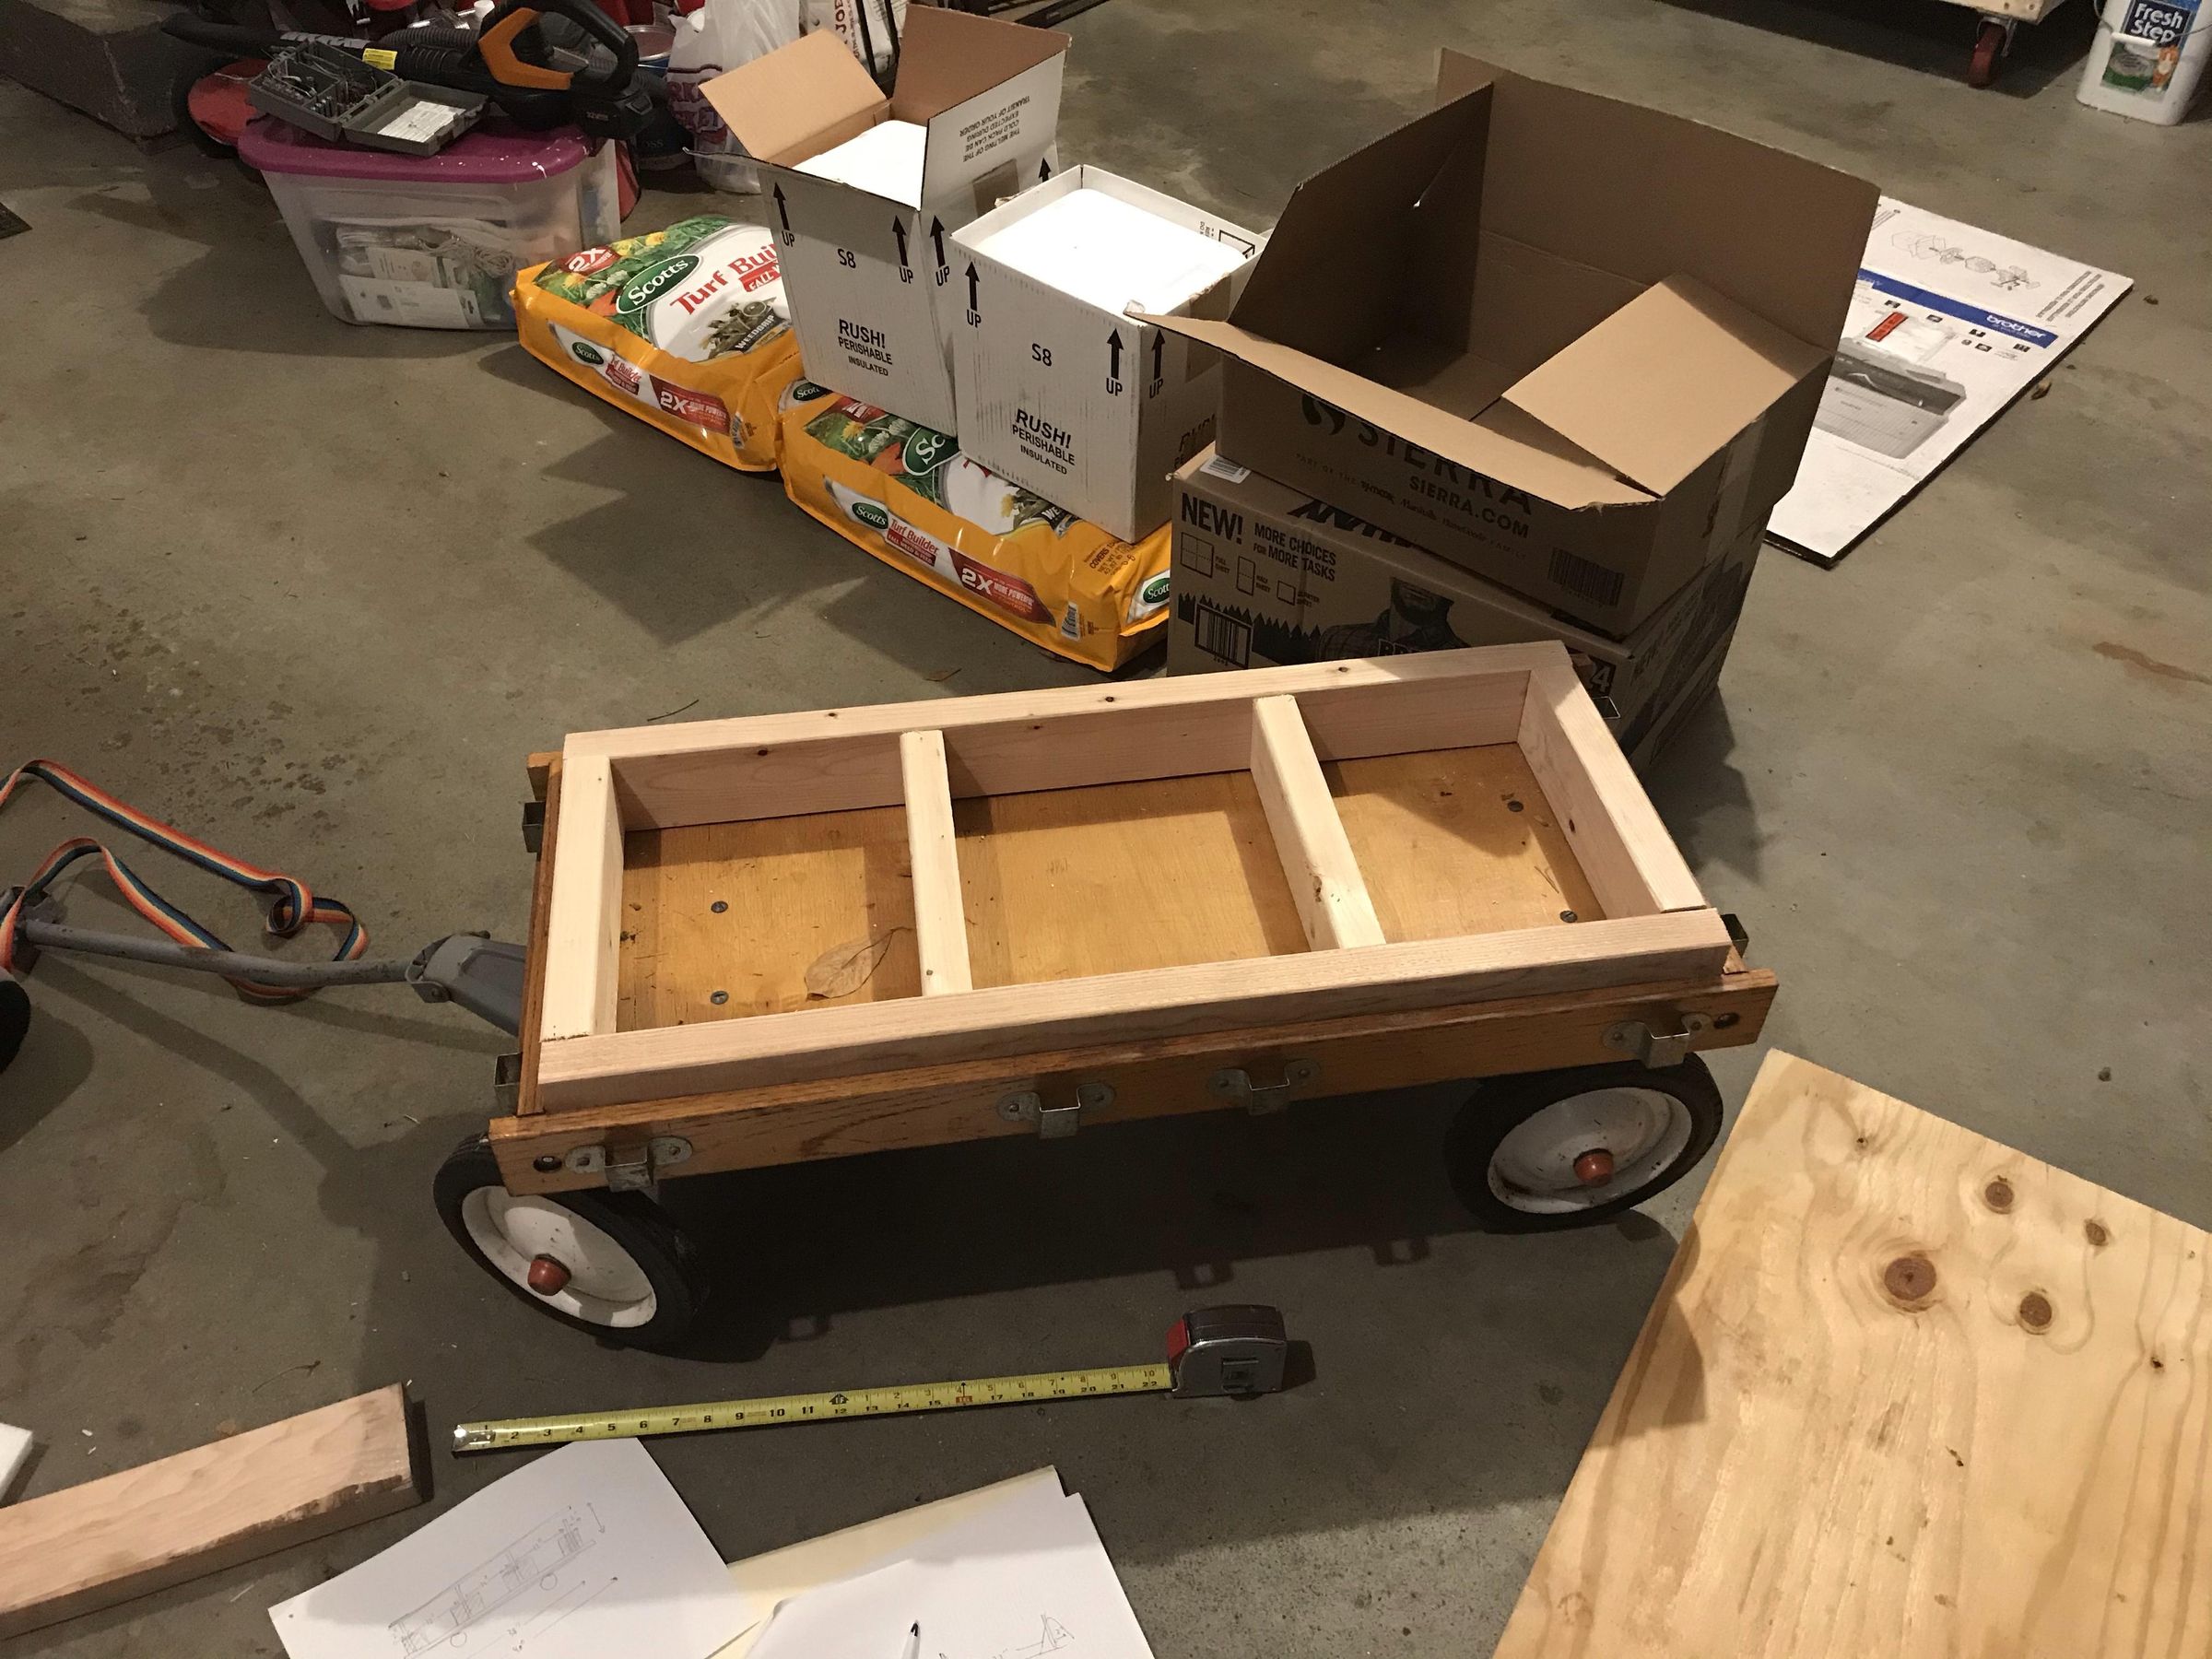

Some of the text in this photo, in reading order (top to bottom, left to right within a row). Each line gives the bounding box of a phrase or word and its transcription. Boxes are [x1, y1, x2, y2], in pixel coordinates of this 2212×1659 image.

[2131, 18, 2176, 43] Step
[2135, 3, 2183, 29] Fresh
[959, 96, 1030, 137] TRANSIT OF YOUR ORDER
[967, 111, 1019, 142] EXPECTED DURING
[963, 128, 1020, 162] THE MELTING OF THE
[966, 120, 1019, 152] COLD PACK CAN BE
[782, 230, 795, 247] UP
[568, 246, 605, 273] 2X
[837, 249, 856, 269] S8
[628, 259, 688, 306] Scotts
[900, 266, 913, 285] UP
[935, 265, 950, 287] UP
[670, 269, 729, 315] Turf
[967, 310, 982, 328] UP
[1986, 314, 2046, 339] brother
[839, 319, 886, 349] RUSH!
[838, 335, 893, 366] PERISHABLE
[1031, 343, 1053, 367] S8
[848, 356, 888, 377] INSULATED
[1106, 377, 1124, 396] UP
[1149, 378, 1164, 399] UP
[660, 391, 688, 415] 2X
[1016, 408, 1072, 449] RUSH!
[1012, 424, 1076, 466] PERISHABLE
[1020, 444, 1067, 475] INSULATED
[856, 506, 887, 525] Scotts
[1181, 492, 1243, 545] NEW!
[1409, 476, 1530, 539] SIERRA.COM
[890, 518, 906, 537] Turf
[907, 528, 939, 555] Builder
[1254, 522, 1337, 566] MORE CHOICES
[1088, 547, 1110, 570] COVERS
[1253, 543, 1335, 582] FOR MORE TASKS
[961, 568, 993, 596] 2X
[511, 1430, 519, 1440] 2
[543, 1429, 551, 1437] 3
[575, 1426, 583, 1434] 4
[607, 1423, 616, 1431] 5
[640, 1420, 648, 1429] 6
[672, 1418, 680, 1426] 7
[704, 1415, 712, 1423] 8
[735, 1412, 744, 1420] 9
[770, 1408, 785, 1418] 10
[802, 1406, 814, 1414] 11
